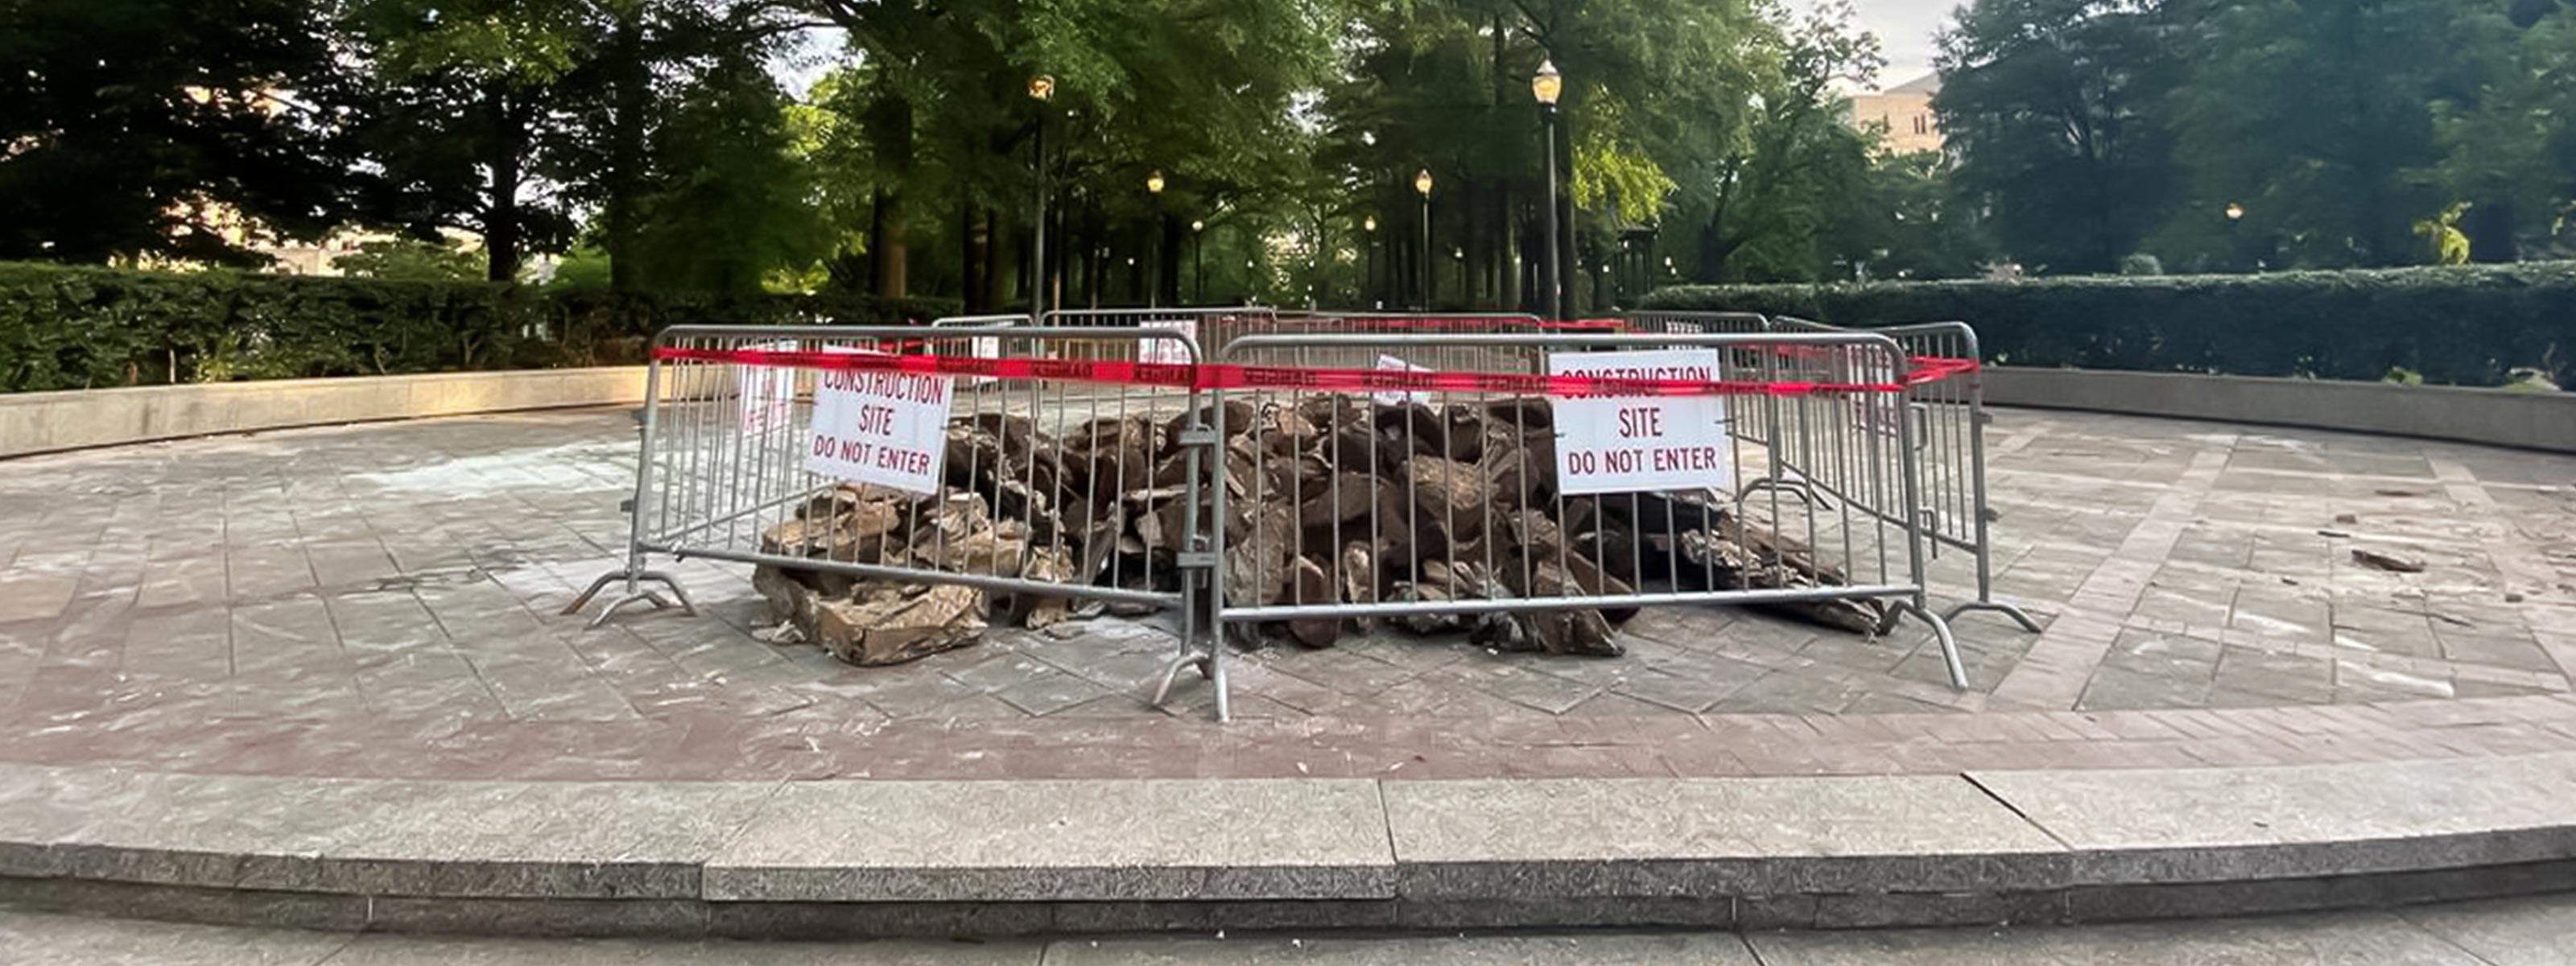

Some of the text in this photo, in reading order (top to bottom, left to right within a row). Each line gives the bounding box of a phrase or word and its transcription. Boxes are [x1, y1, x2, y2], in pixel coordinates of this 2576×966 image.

[824, 371, 945, 405] CONSTRUCTION
[859, 404, 895, 436] SITE
[1619, 407, 1662, 438] SITE
[813, 434, 930, 476] DO NOT ENTER
[1568, 448, 1717, 475] DO NOT ENTER
